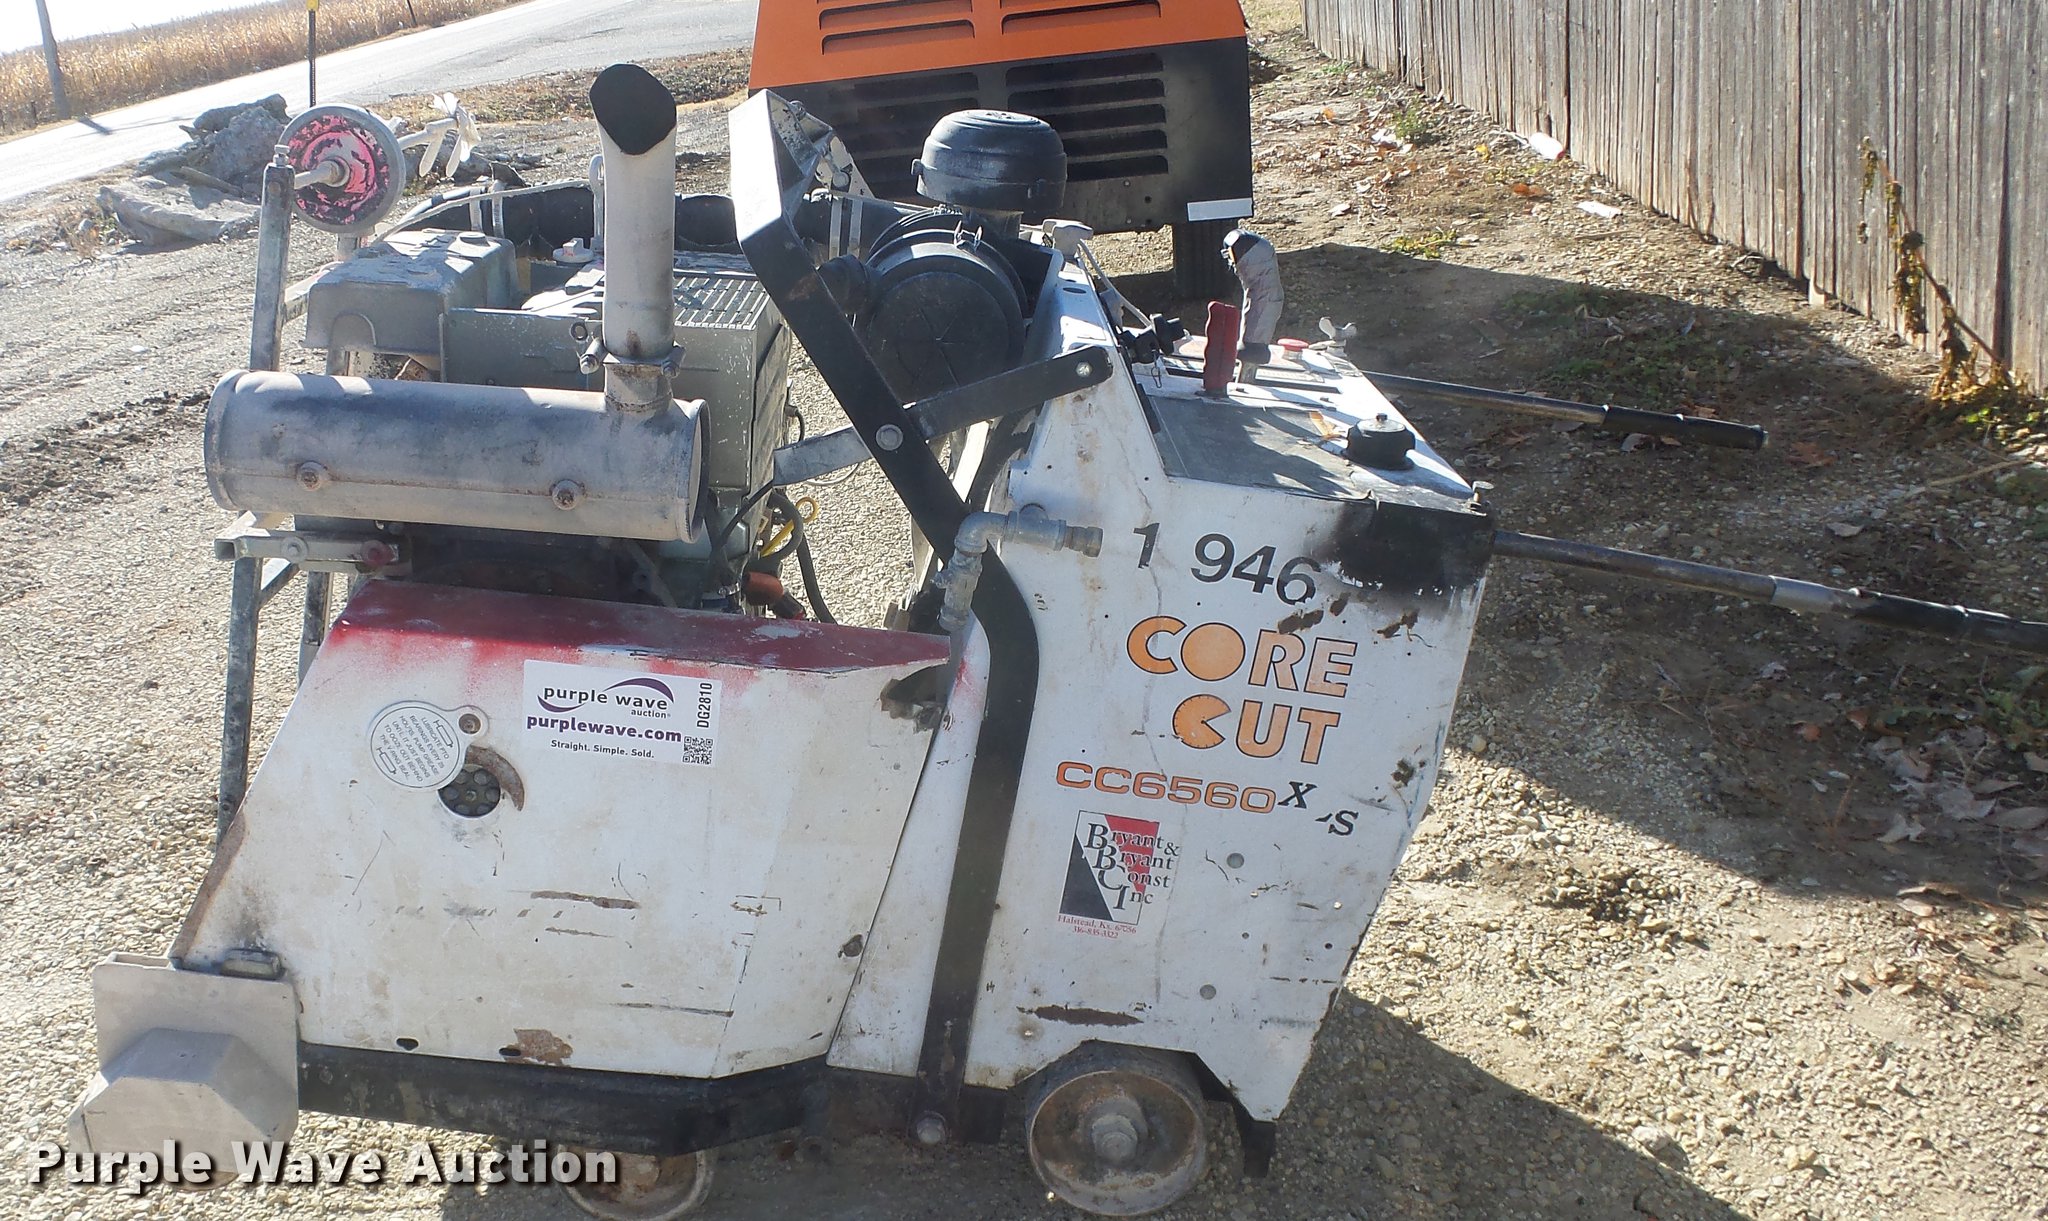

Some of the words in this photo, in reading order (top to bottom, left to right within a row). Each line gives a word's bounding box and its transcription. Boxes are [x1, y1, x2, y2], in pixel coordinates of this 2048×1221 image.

[1126, 615, 1358, 698] CORE
[543, 687, 608, 704] purple
[615, 693, 668, 710] wave
[696, 682, 713, 729] DG2810
[630, 708, 667, 719] auction
[526, 715, 683, 743] purplewave.com
[1172, 693, 1341, 765] CUT
[550, 739, 591, 752] Straight.
[593, 744, 629, 756] Simple.
[631, 748, 655, 759] Sold.
[1084, 823, 1164, 854] Bryant
[1164, 842, 1180, 856] &
[1092, 844, 1175, 870] Bryant
[1097, 864, 1170, 891] Const
[1112, 885, 1154, 910] Inc
